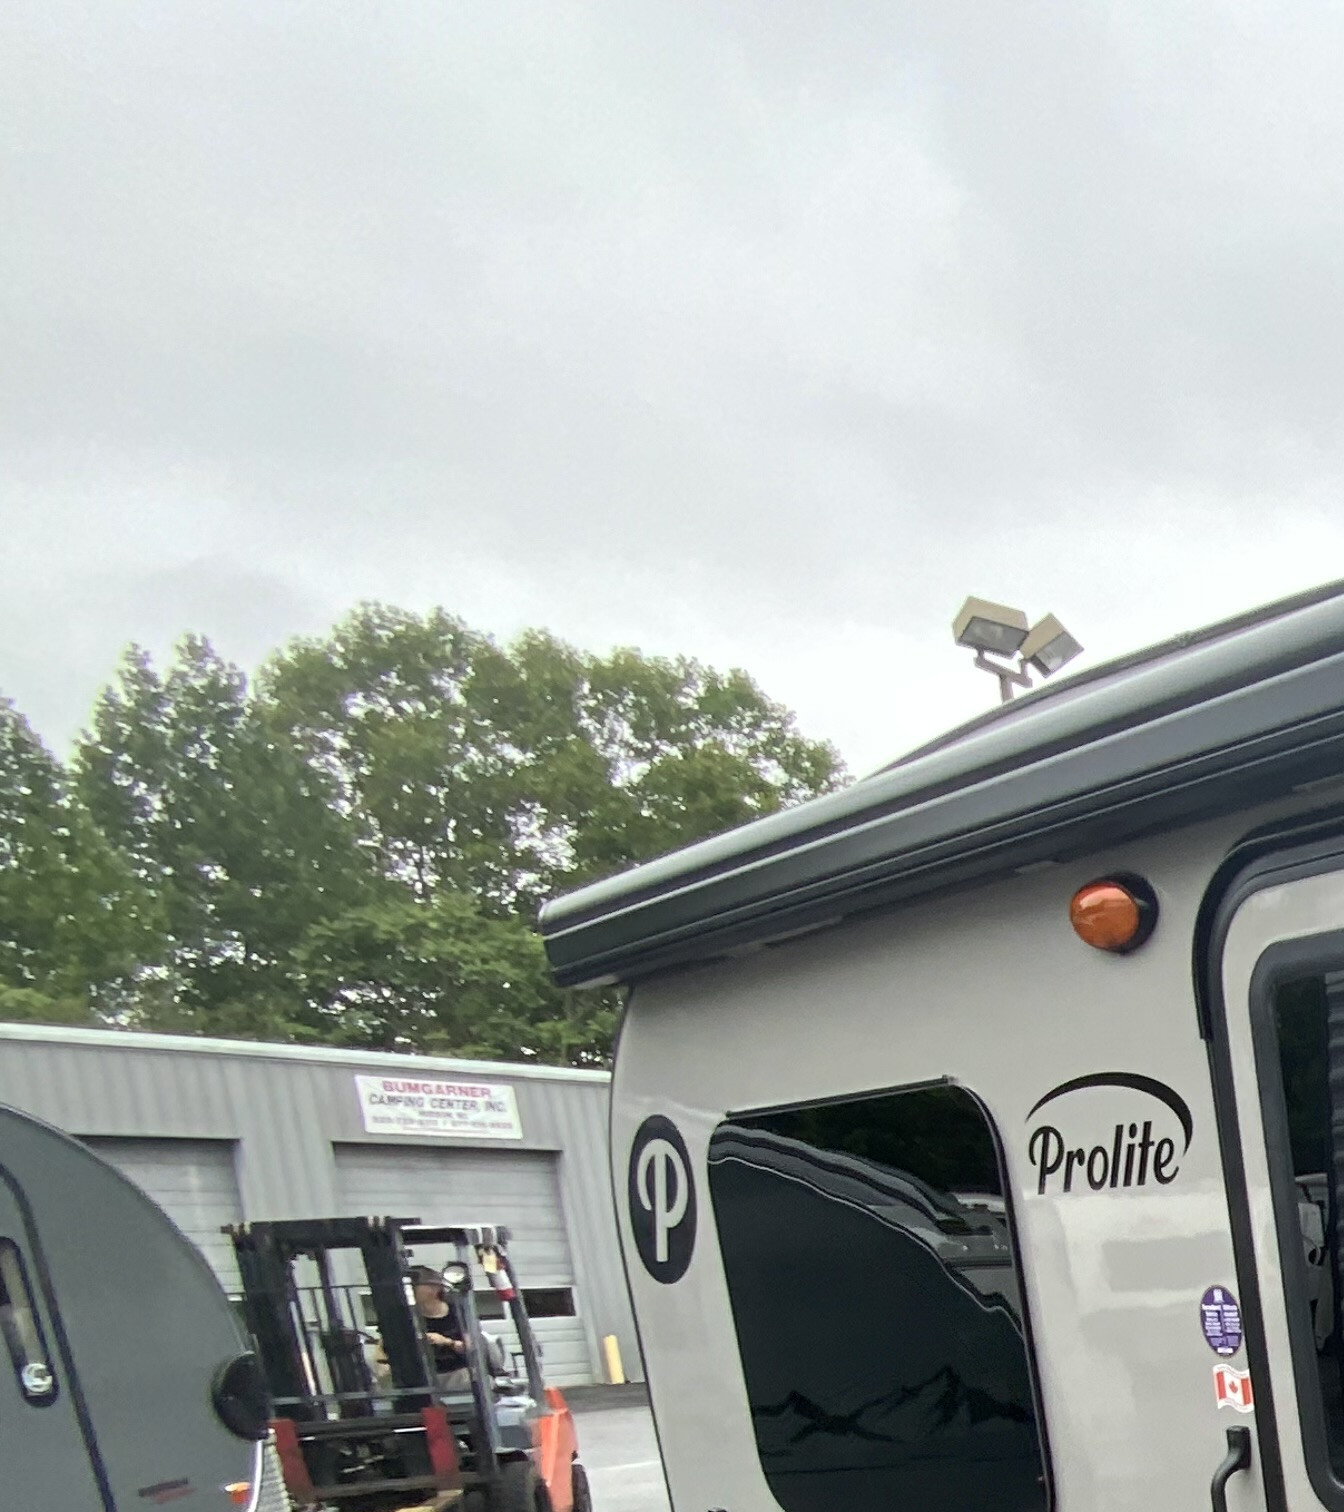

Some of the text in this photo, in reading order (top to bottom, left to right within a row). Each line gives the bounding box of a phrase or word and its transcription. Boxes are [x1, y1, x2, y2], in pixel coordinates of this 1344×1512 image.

[368, 1093, 425, 1108] CAMPING
[381, 1080, 492, 1098] BUMGARNER
[1027, 1120, 1180, 1196] Prolite
[636, 1138, 689, 1263] P
